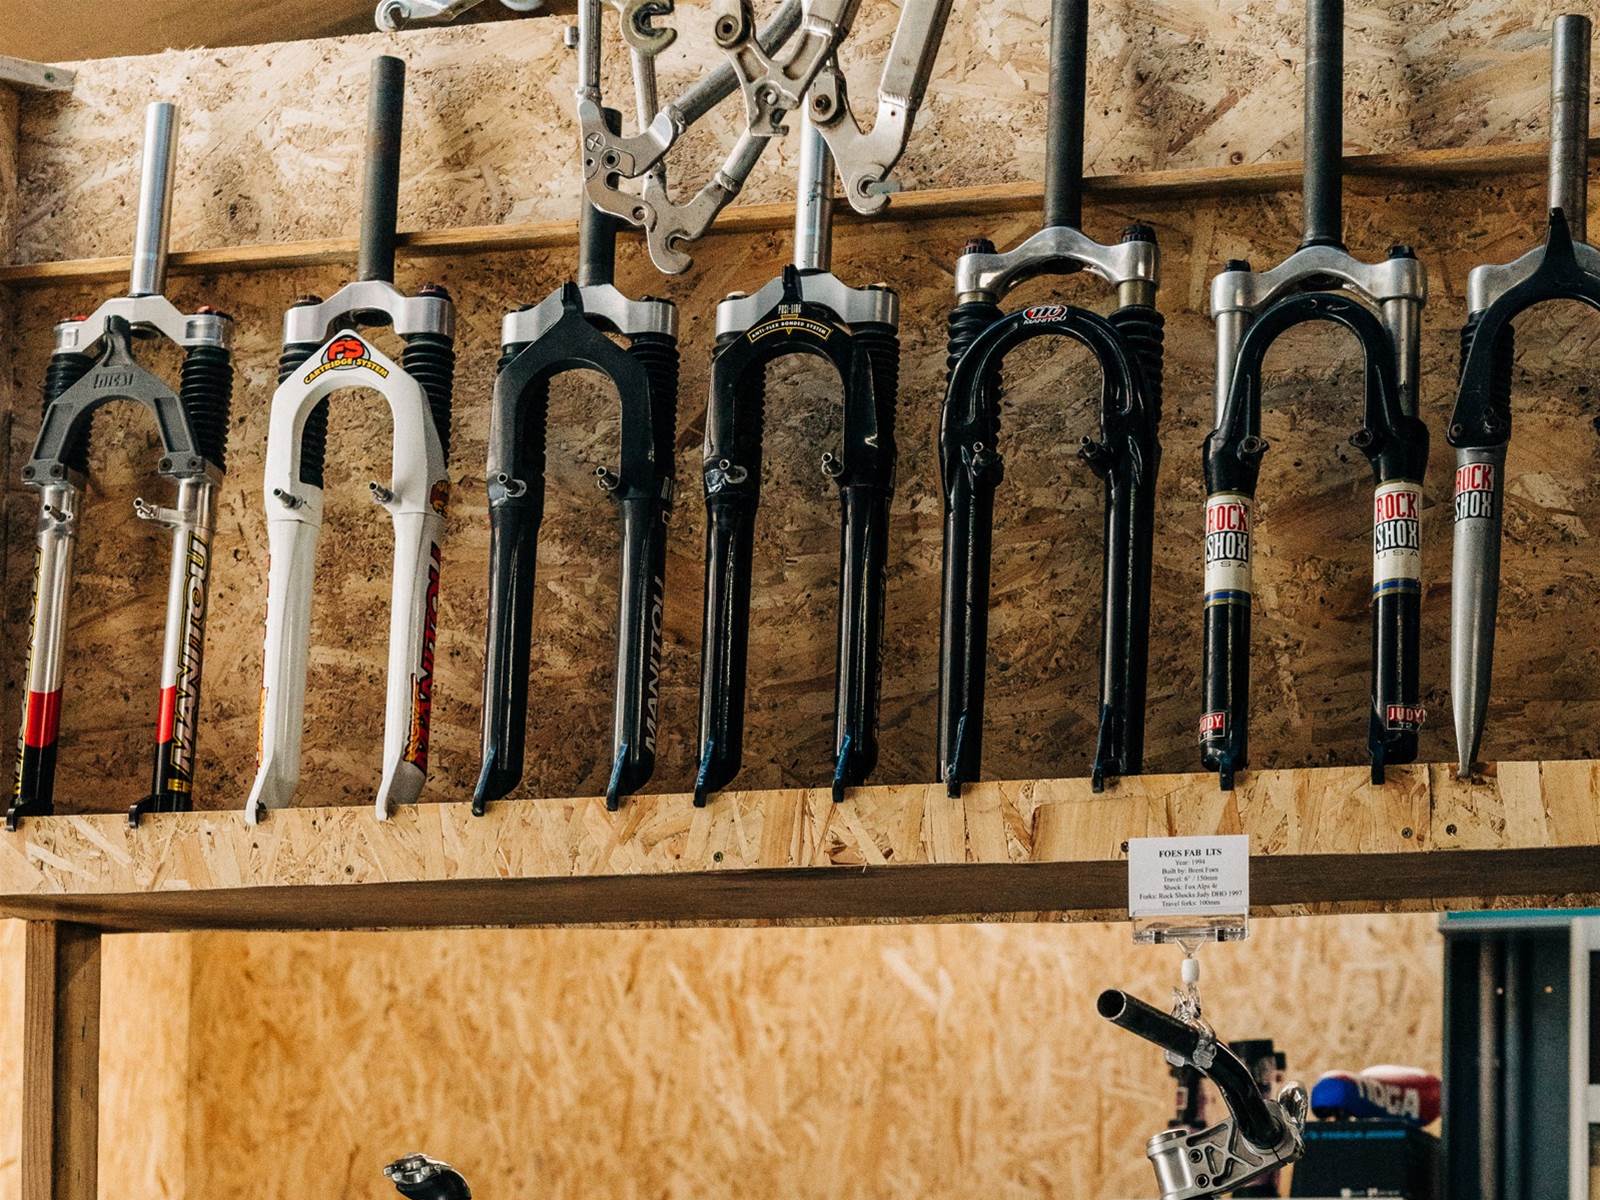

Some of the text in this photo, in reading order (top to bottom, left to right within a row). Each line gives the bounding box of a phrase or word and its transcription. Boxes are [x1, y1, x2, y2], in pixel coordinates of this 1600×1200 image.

[328, 338, 365, 361] FS
[304, 358, 389, 384] CARTRIDGE SYSTEM
[1456, 464, 1492, 497] ROCK
[1207, 505, 1249, 533] ROCK
[1376, 493, 1418, 523] ROCK
[1454, 491, 1492, 522] SHOX
[1206, 531, 1249, 560] SHOX
[1375, 519, 1419, 552] SHOX
[170, 530, 209, 782] MANITOU
[645, 575, 664, 755] MANITOU
[1200, 714, 1222, 733] UDY
[1389, 707, 1421, 722] JUDY
[1158, 848, 1222, 858] FOES FAB LTS
